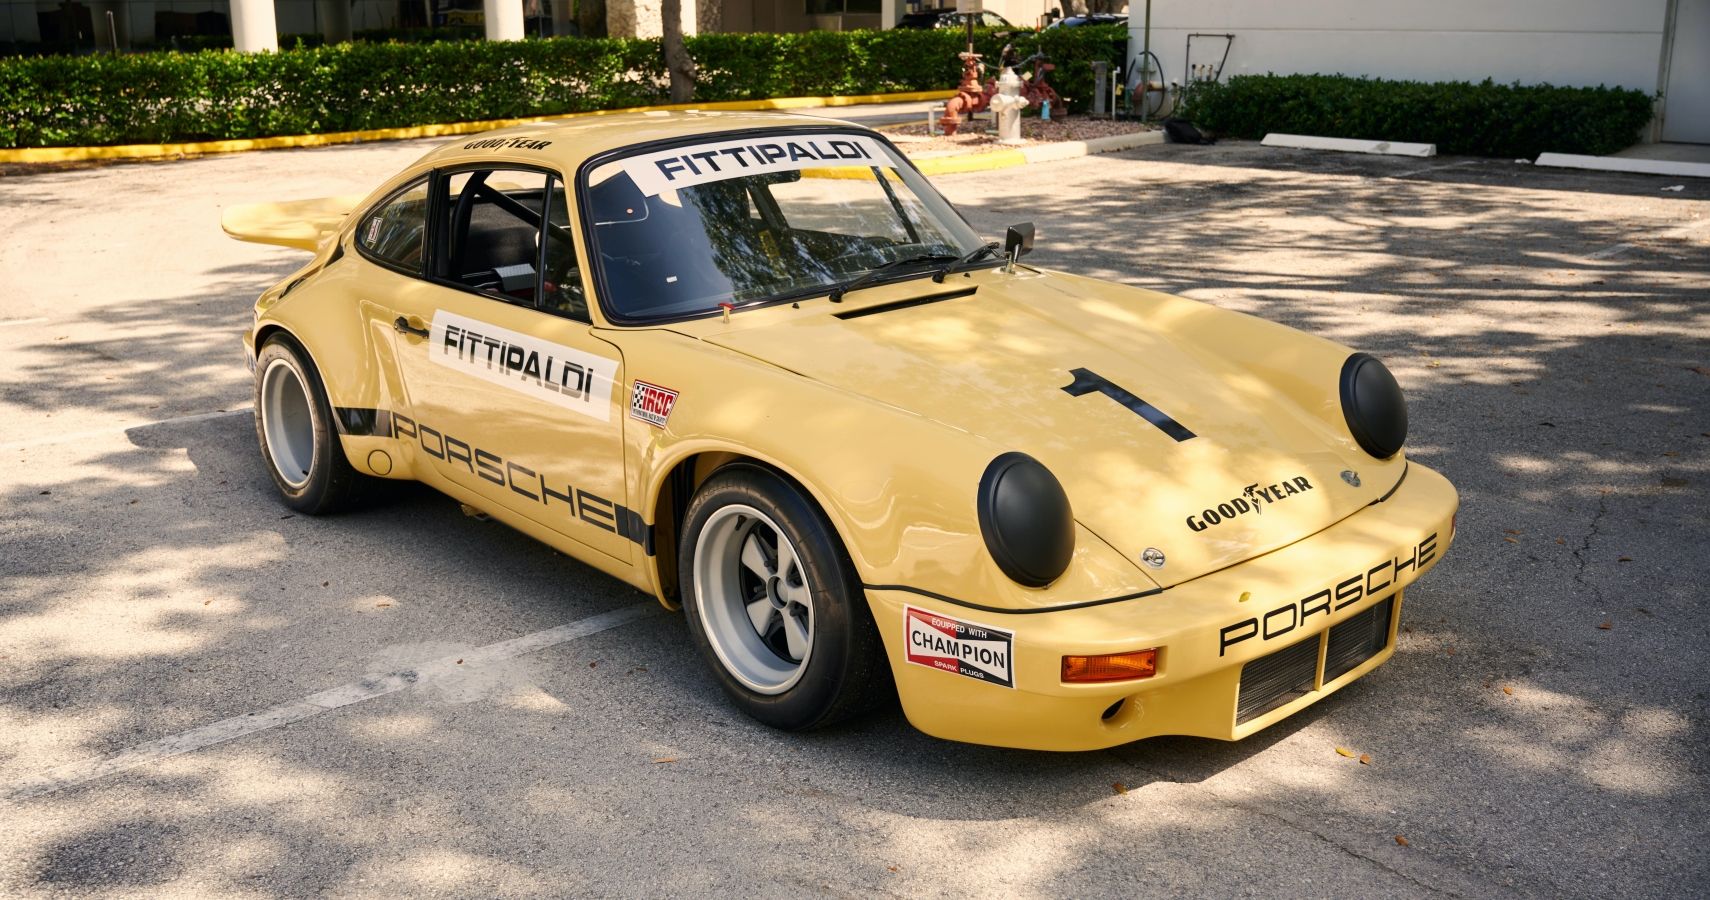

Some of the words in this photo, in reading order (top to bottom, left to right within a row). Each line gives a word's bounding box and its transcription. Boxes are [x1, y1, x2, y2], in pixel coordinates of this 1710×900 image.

[654, 140, 873, 181] FITTIPALDI
[444, 325, 594, 402] FITTIPALDI
[642, 388, 674, 416] IROC
[1060, 367, 1198, 442] 1
[392, 412, 616, 534] PORSCHE
[1219, 532, 1438, 657] PORSCHE
[912, 630, 1005, 668] CHAMPION
[931, 618, 965, 633] EQUIPPED
[968, 628, 987, 639] WITH
[934, 660, 958, 672] SPARK
[960, 667, 985, 679] PLUGS
